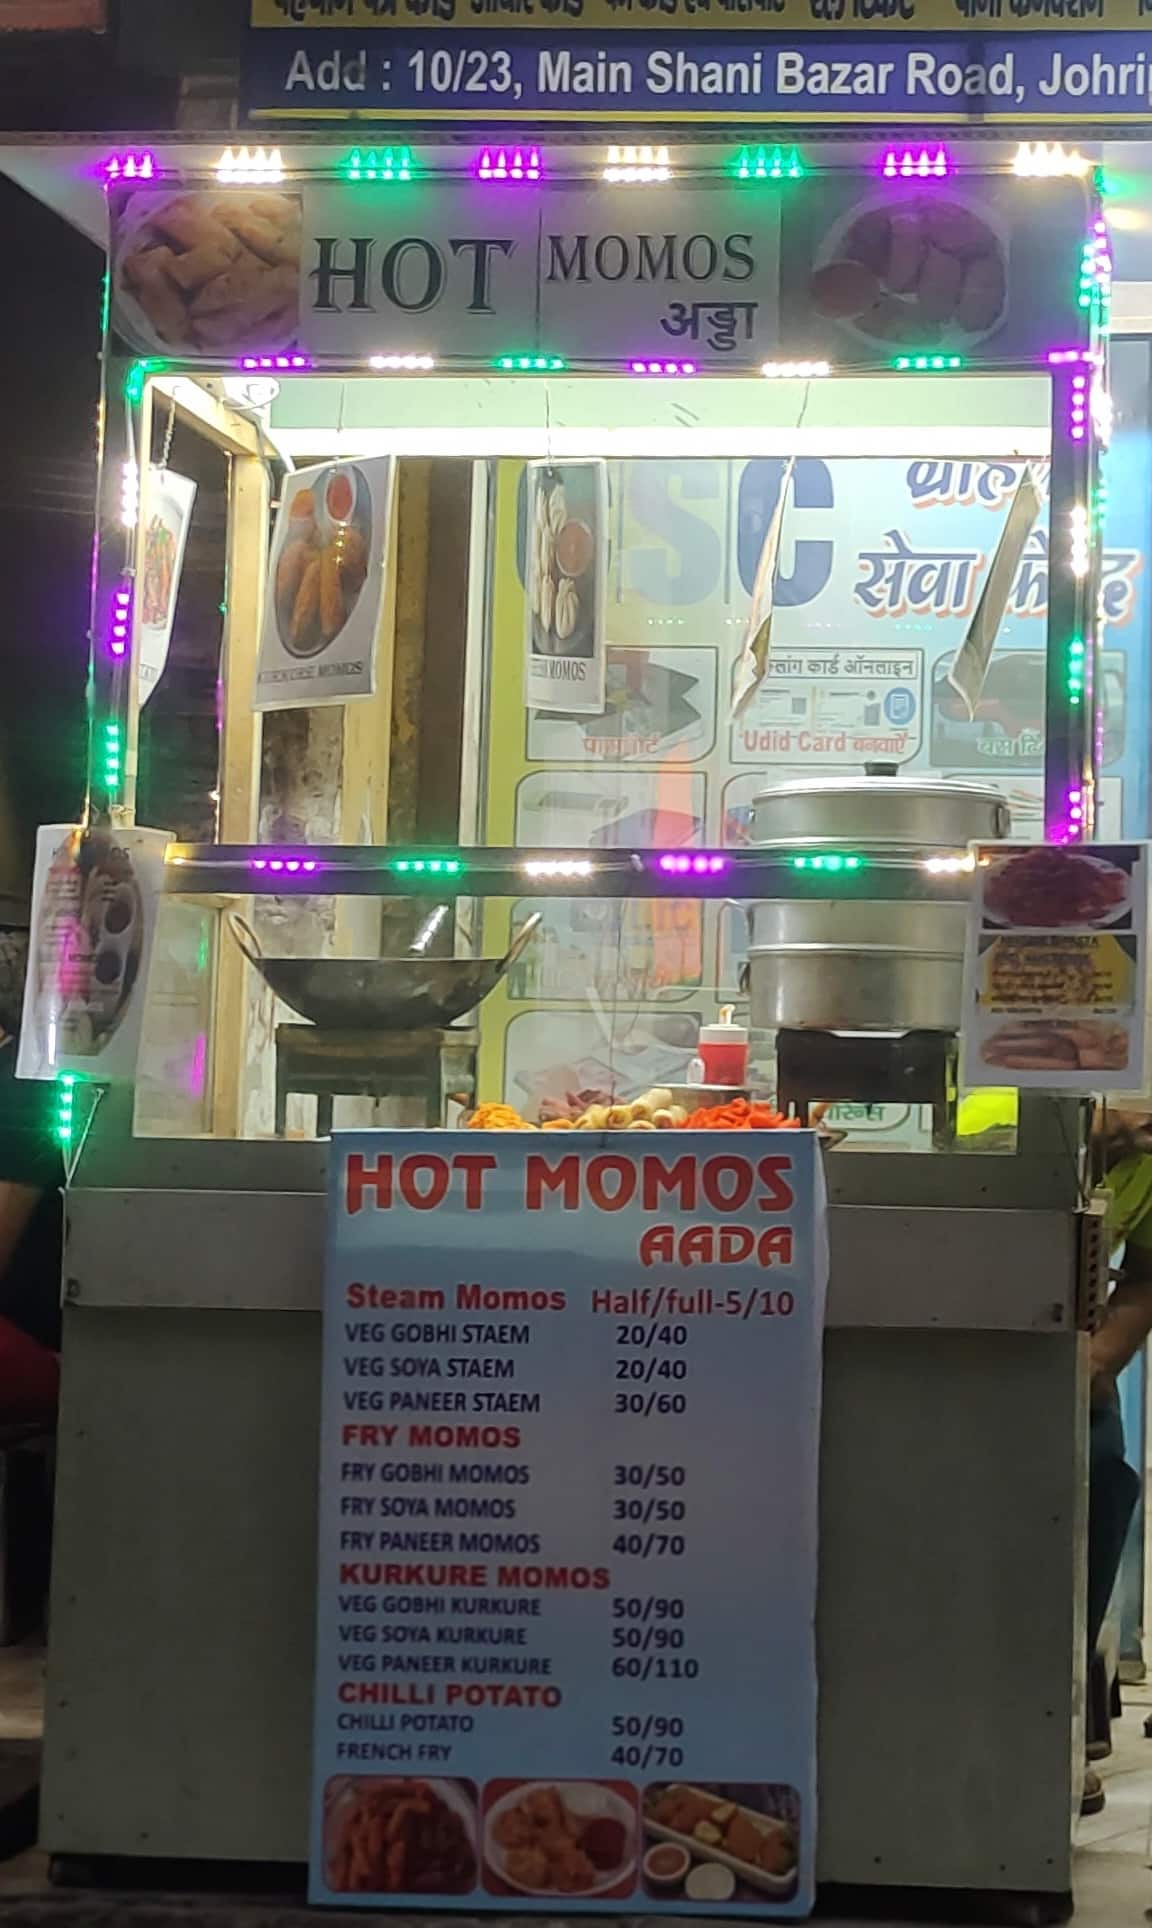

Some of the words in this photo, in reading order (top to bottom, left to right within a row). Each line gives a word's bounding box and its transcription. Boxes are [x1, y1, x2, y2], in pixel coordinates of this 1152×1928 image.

[284, 49, 366, 91] Add
[382, 58, 391, 91] :
[408, 49, 522, 99] 10/23,
[538, 51, 631, 93] Main
[646, 51, 762, 95] Shani
[776, 52, 894, 95] Bazar
[906, 53, 1025, 103] Road,
[1038, 53, 1152, 105] Johri
[309, 236, 518, 315] HOT
[547, 234, 756, 284] MOMOS
[660, 302, 758, 351] अड्डा
[854, 529, 977, 609] सेवा
[808, 653, 840, 675] कार्ड
[844, 654, 914, 677] ऑनलाइन
[742, 729, 791, 751] Udid
[797, 731, 846, 751] Card
[345, 1153, 497, 1214] HOT
[524, 1154, 795, 1213] MOMOS
[638, 1224, 794, 1267] AADA
[346, 1282, 444, 1310] Steam
[456, 1284, 566, 1311] Momos
[591, 1287, 795, 1319] Half/full-5/10
[345, 1323, 384, 1343] VEG
[391, 1324, 456, 1344] GOBHI
[462, 1324, 530, 1345] STAEM
[616, 1324, 687, 1346] 20/40
[344, 1357, 384, 1377] VEG
[391, 1357, 441, 1377] SOYA
[447, 1358, 514, 1378] STAEM
[615, 1358, 687, 1381] 20/40
[344, 1391, 383, 1411] VEG
[390, 1392, 466, 1412] PANEER
[473, 1393, 540, 1413] STAEM
[615, 1393, 686, 1416] 30/60
[342, 1424, 398, 1446] FRY
[409, 1425, 521, 1448] MOMOS
[341, 1463, 374, 1483] FRY
[381, 1463, 443, 1484] GOBHI
[449, 1465, 530, 1485] MOMOS
[614, 1466, 685, 1488] 30/50
[340, 1497, 374, 1516] FRY
[380, 1498, 429, 1517] SOYA
[434, 1499, 516, 1519] MOMOS
[613, 1500, 685, 1522] 30/50
[340, 1531, 374, 1551] FRY
[380, 1532, 453, 1552] PANEER
[459, 1533, 540, 1554] MOMOS
[612, 1535, 685, 1557] 40/70
[339, 1563, 487, 1587] KURKURE
[497, 1566, 610, 1589] MOMOS
[338, 1595, 376, 1613] VEG
[382, 1596, 445, 1615] GOBHI
[450, 1598, 541, 1617] KURKURE
[612, 1599, 684, 1620] 50/90
[338, 1625, 376, 1643] VEG
[381, 1626, 431, 1644] SOYA
[436, 1627, 527, 1645] KURKURE
[612, 1628, 684, 1649] 50/90
[338, 1655, 375, 1673] VEG
[381, 1656, 455, 1674] PANEER
[461, 1657, 552, 1676] KURKURE
[612, 1658, 699, 1680] 60/110
[338, 1683, 435, 1705] CHILLI
[445, 1684, 562, 1708] POTATO
[337, 1713, 395, 1731] CHILLI
[401, 1714, 474, 1733] POTATO
[612, 1716, 683, 1738] 50/90
[337, 1743, 411, 1761] FRENCH
[418, 1744, 452, 1762] FRY
[611, 1746, 683, 1767] 40/70
